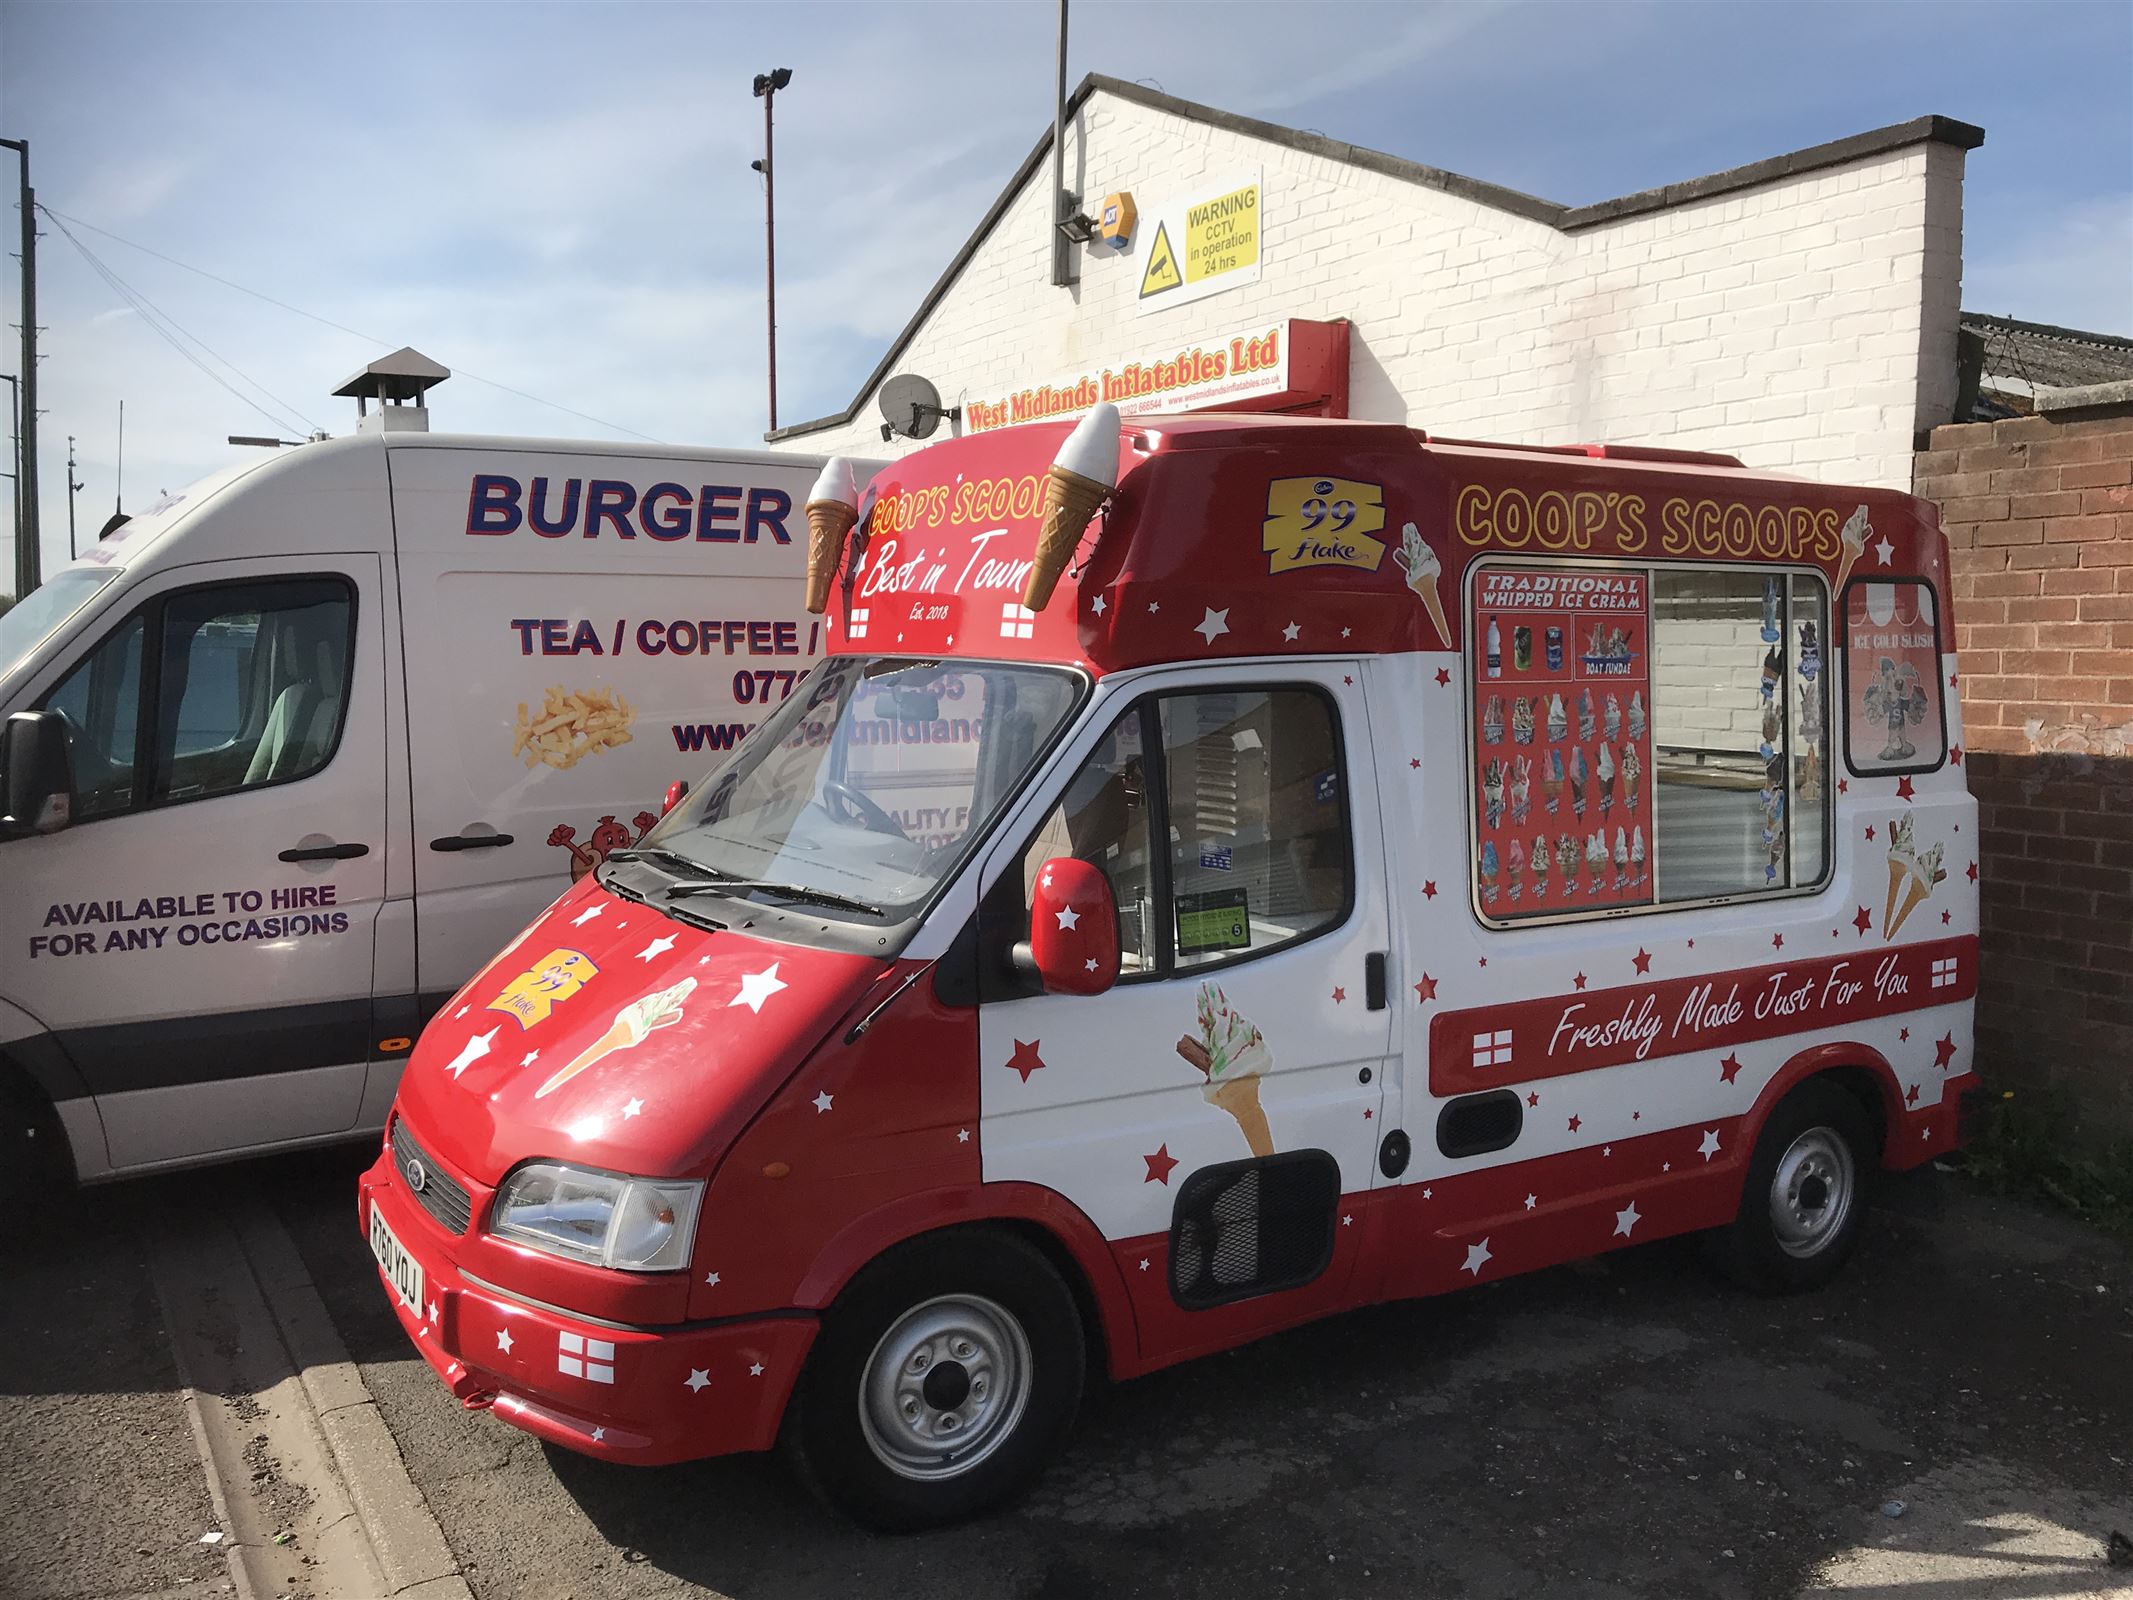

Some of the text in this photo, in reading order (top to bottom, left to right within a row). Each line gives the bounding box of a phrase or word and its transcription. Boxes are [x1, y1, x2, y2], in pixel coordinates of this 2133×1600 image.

[1189, 189, 1255, 228] WARNING
[1190, 231, 1252, 261] in operation
[1205, 218, 1235, 241] CCTV
[1204, 255, 1236, 275] 24 hrs
[967, 328, 1279, 432] West Midlands Inflatables Ltd
[466, 474, 792, 545] BURGER
[869, 484, 949, 537] COOP'S
[1301, 498, 1356, 532] 99
[1455, 484, 1841, 561] COOP'S SCOOPS
[861, 528, 1034, 599] Best in Town
[1287, 537, 1366, 561] Flake
[1483, 592, 1640, 609] WHIPPED ICE CREAM
[1487, 575, 1639, 593] TRADITIONAL
[925, 605, 949, 621] 2018
[510, 619, 819, 656] TEA / COFFEE /
[1854, 633, 1935, 649] ICE COLD SLUSH
[1586, 663, 1631, 675] BOAT SUNDAE
[43, 885, 337, 928] AVAILABLE TO HIRE
[29, 912, 349, 958] FOR ANY OCCASIONS
[1234, 925, 1241, 936] 5
[1547, 954, 1909, 1060] Freshly Made Just For You
[395, 1245, 416, 1305] YOJ
